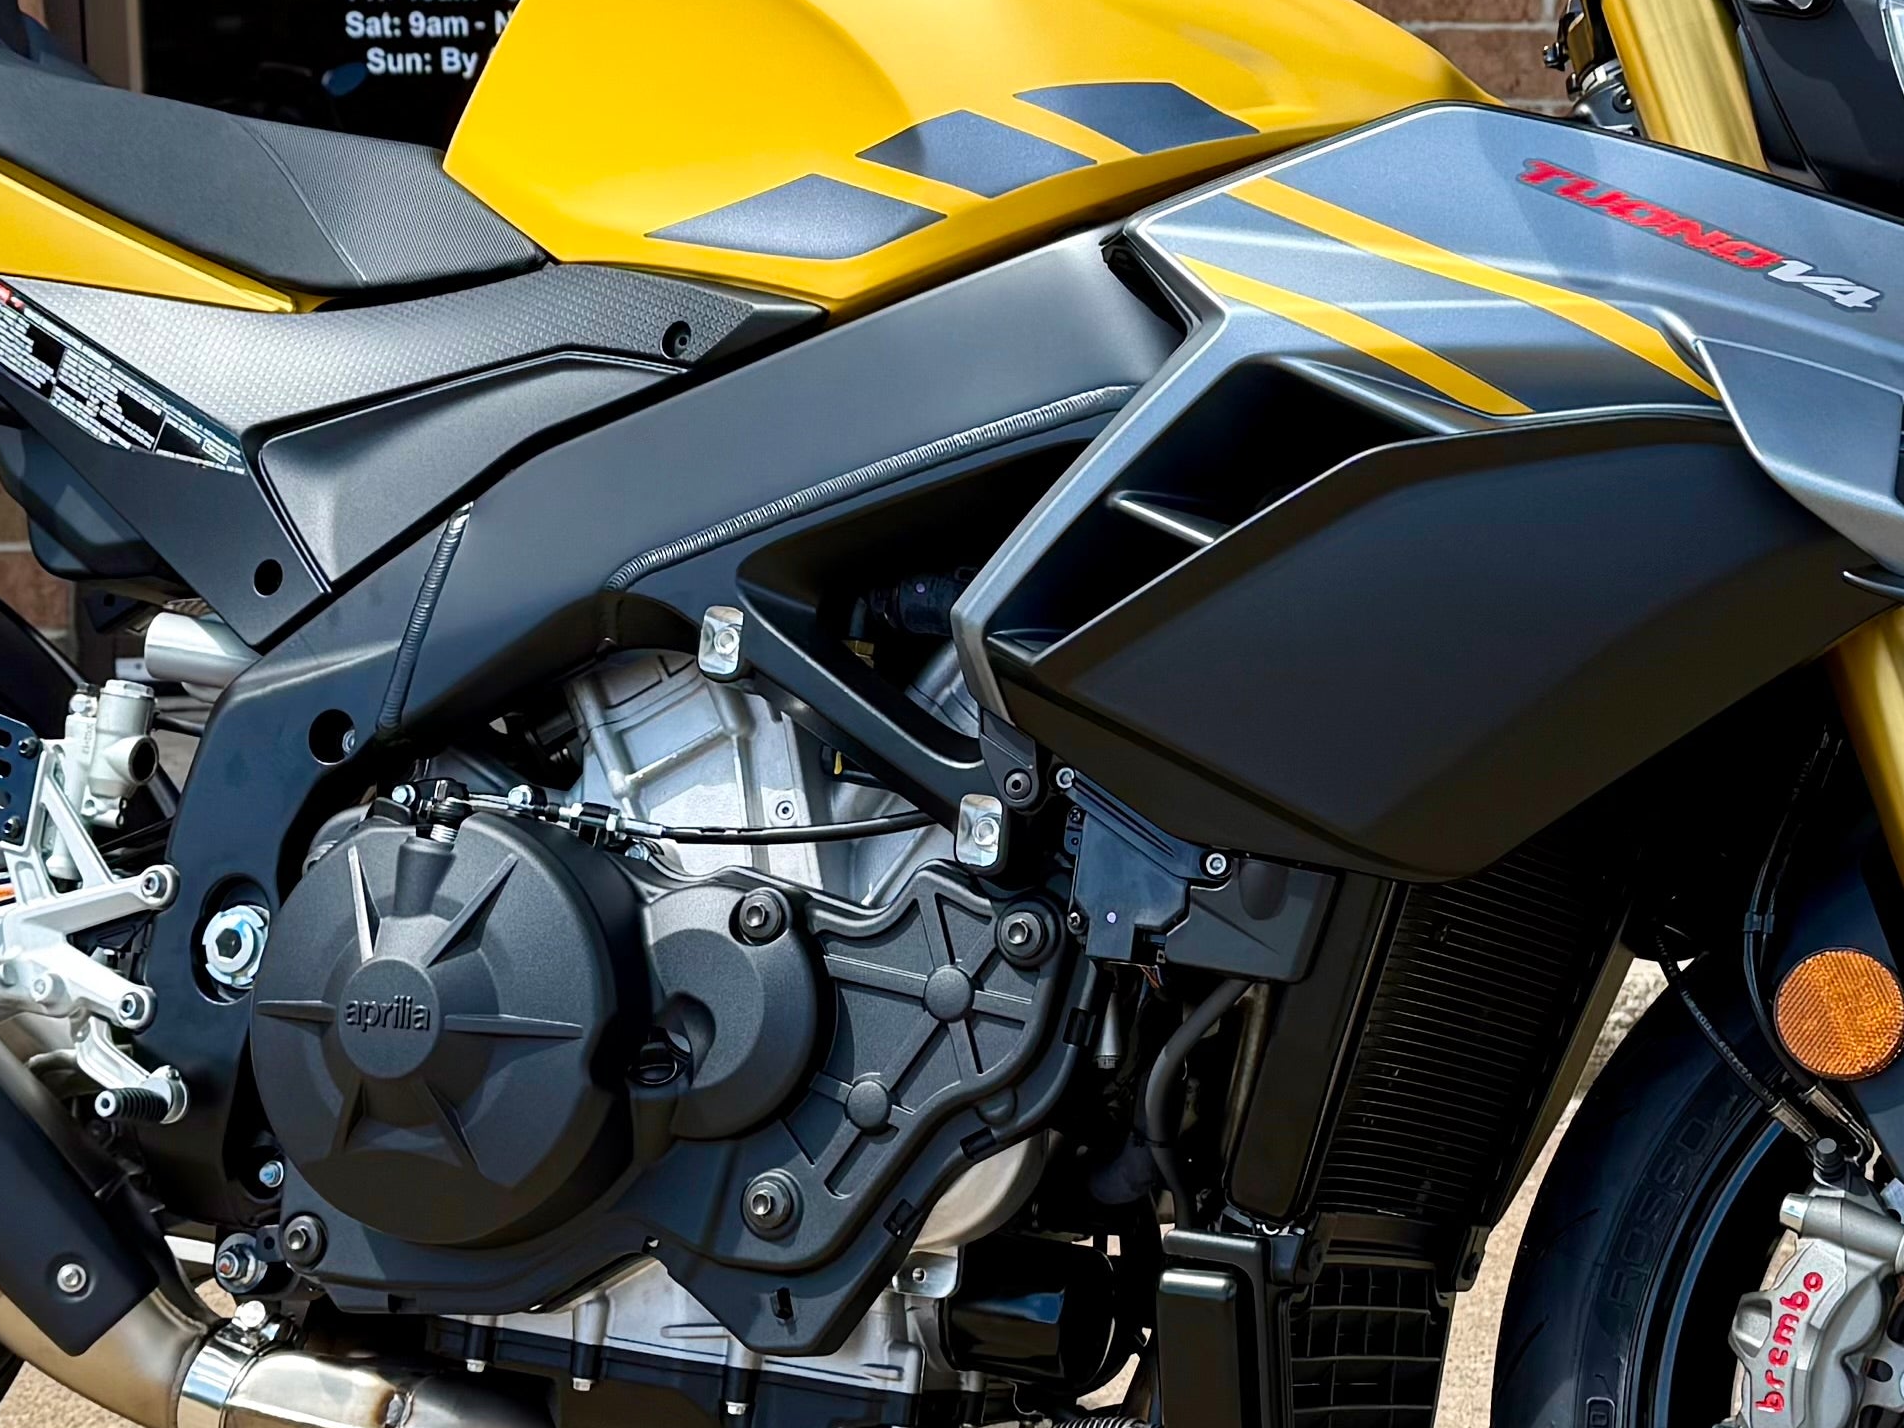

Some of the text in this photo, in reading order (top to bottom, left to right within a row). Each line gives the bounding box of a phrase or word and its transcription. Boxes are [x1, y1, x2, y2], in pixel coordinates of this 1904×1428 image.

[345, 10, 402, 38] Sat:
[408, 11, 469, 38] 9am
[366, 47, 479, 80] Sun: By
[343, 994, 431, 1033] aprilia
[1754, 1270, 1825, 1414] brembo
